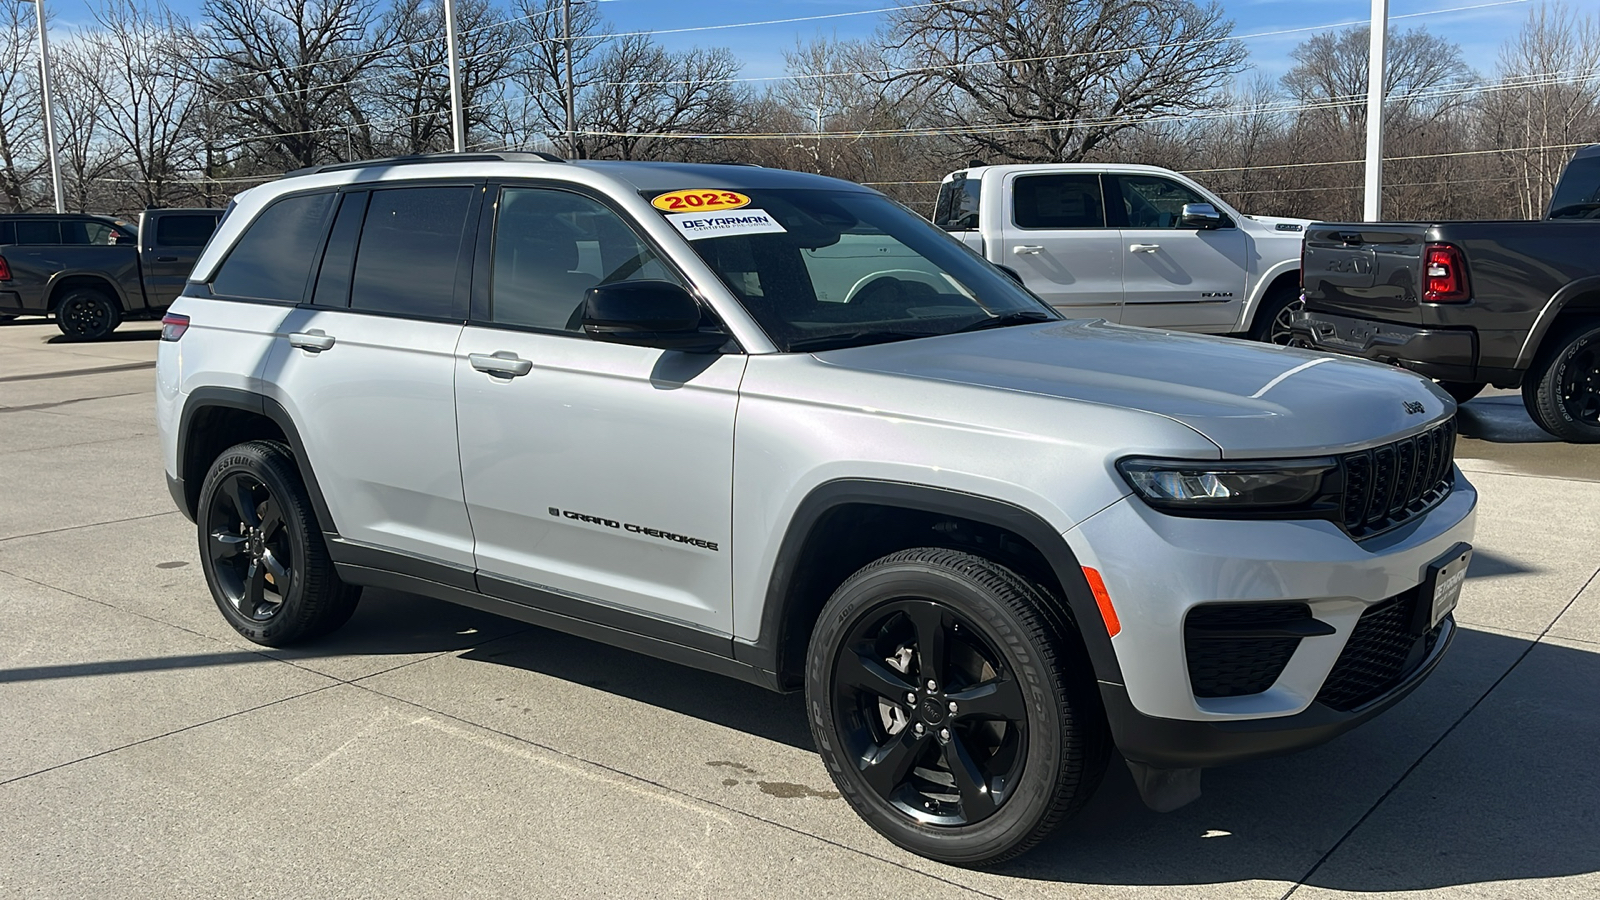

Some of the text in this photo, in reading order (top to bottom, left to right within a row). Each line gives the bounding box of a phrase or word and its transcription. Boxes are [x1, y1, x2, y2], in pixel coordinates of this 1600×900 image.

[664, 193, 742, 209] 2023
[682, 216, 769, 229] DEYARMAN
[1325, 260, 1379, 275] RAM
[563, 510, 620, 529] GRAND
[624, 523, 719, 552] CHEROKEE
